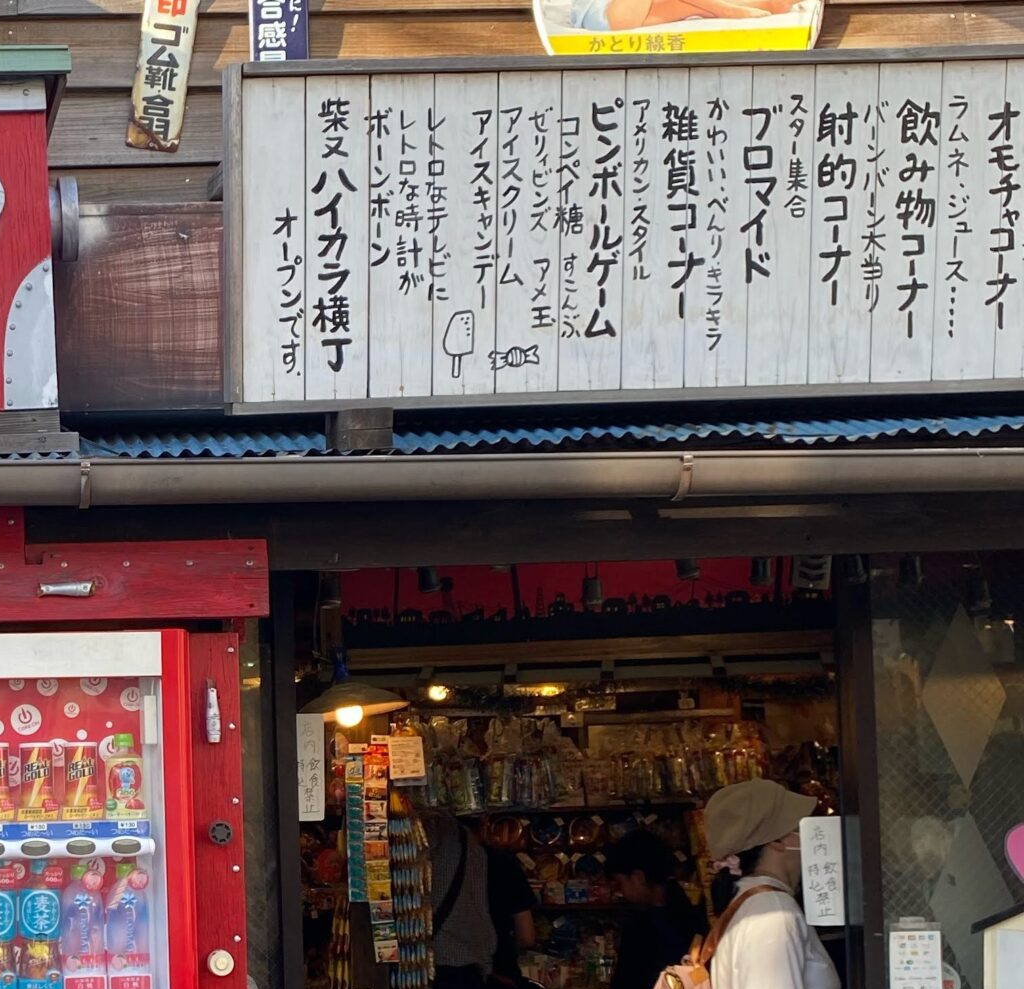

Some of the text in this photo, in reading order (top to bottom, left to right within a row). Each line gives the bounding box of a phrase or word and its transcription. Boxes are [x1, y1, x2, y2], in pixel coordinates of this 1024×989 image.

[589, 35, 686, 52] かとり線香
[311, 97, 358, 373] 柴又ハイカラ横丁
[364, 107, 394, 267] ボーンボーン
[395, 110, 424, 294] レトロな時計が
[426, 108, 449, 301] レトロなテレビに
[470, 110, 498, 309] アイスキャンデー
[500, 106, 525, 285] アイスクリーム
[585, 98, 625, 337] ピンボールゲーム
[663, 102, 705, 318] 雑貨コーナー
[740, 104, 783, 283] ブロマイド
[784, 95, 808, 218] スター集合
[817, 102, 858, 305] 射的コーナー
[895, 99, 939, 338] 飲み物コーナー
[986, 102, 1021, 330] オモチャコーナー
[33, 895, 51, 930] 麦茶
